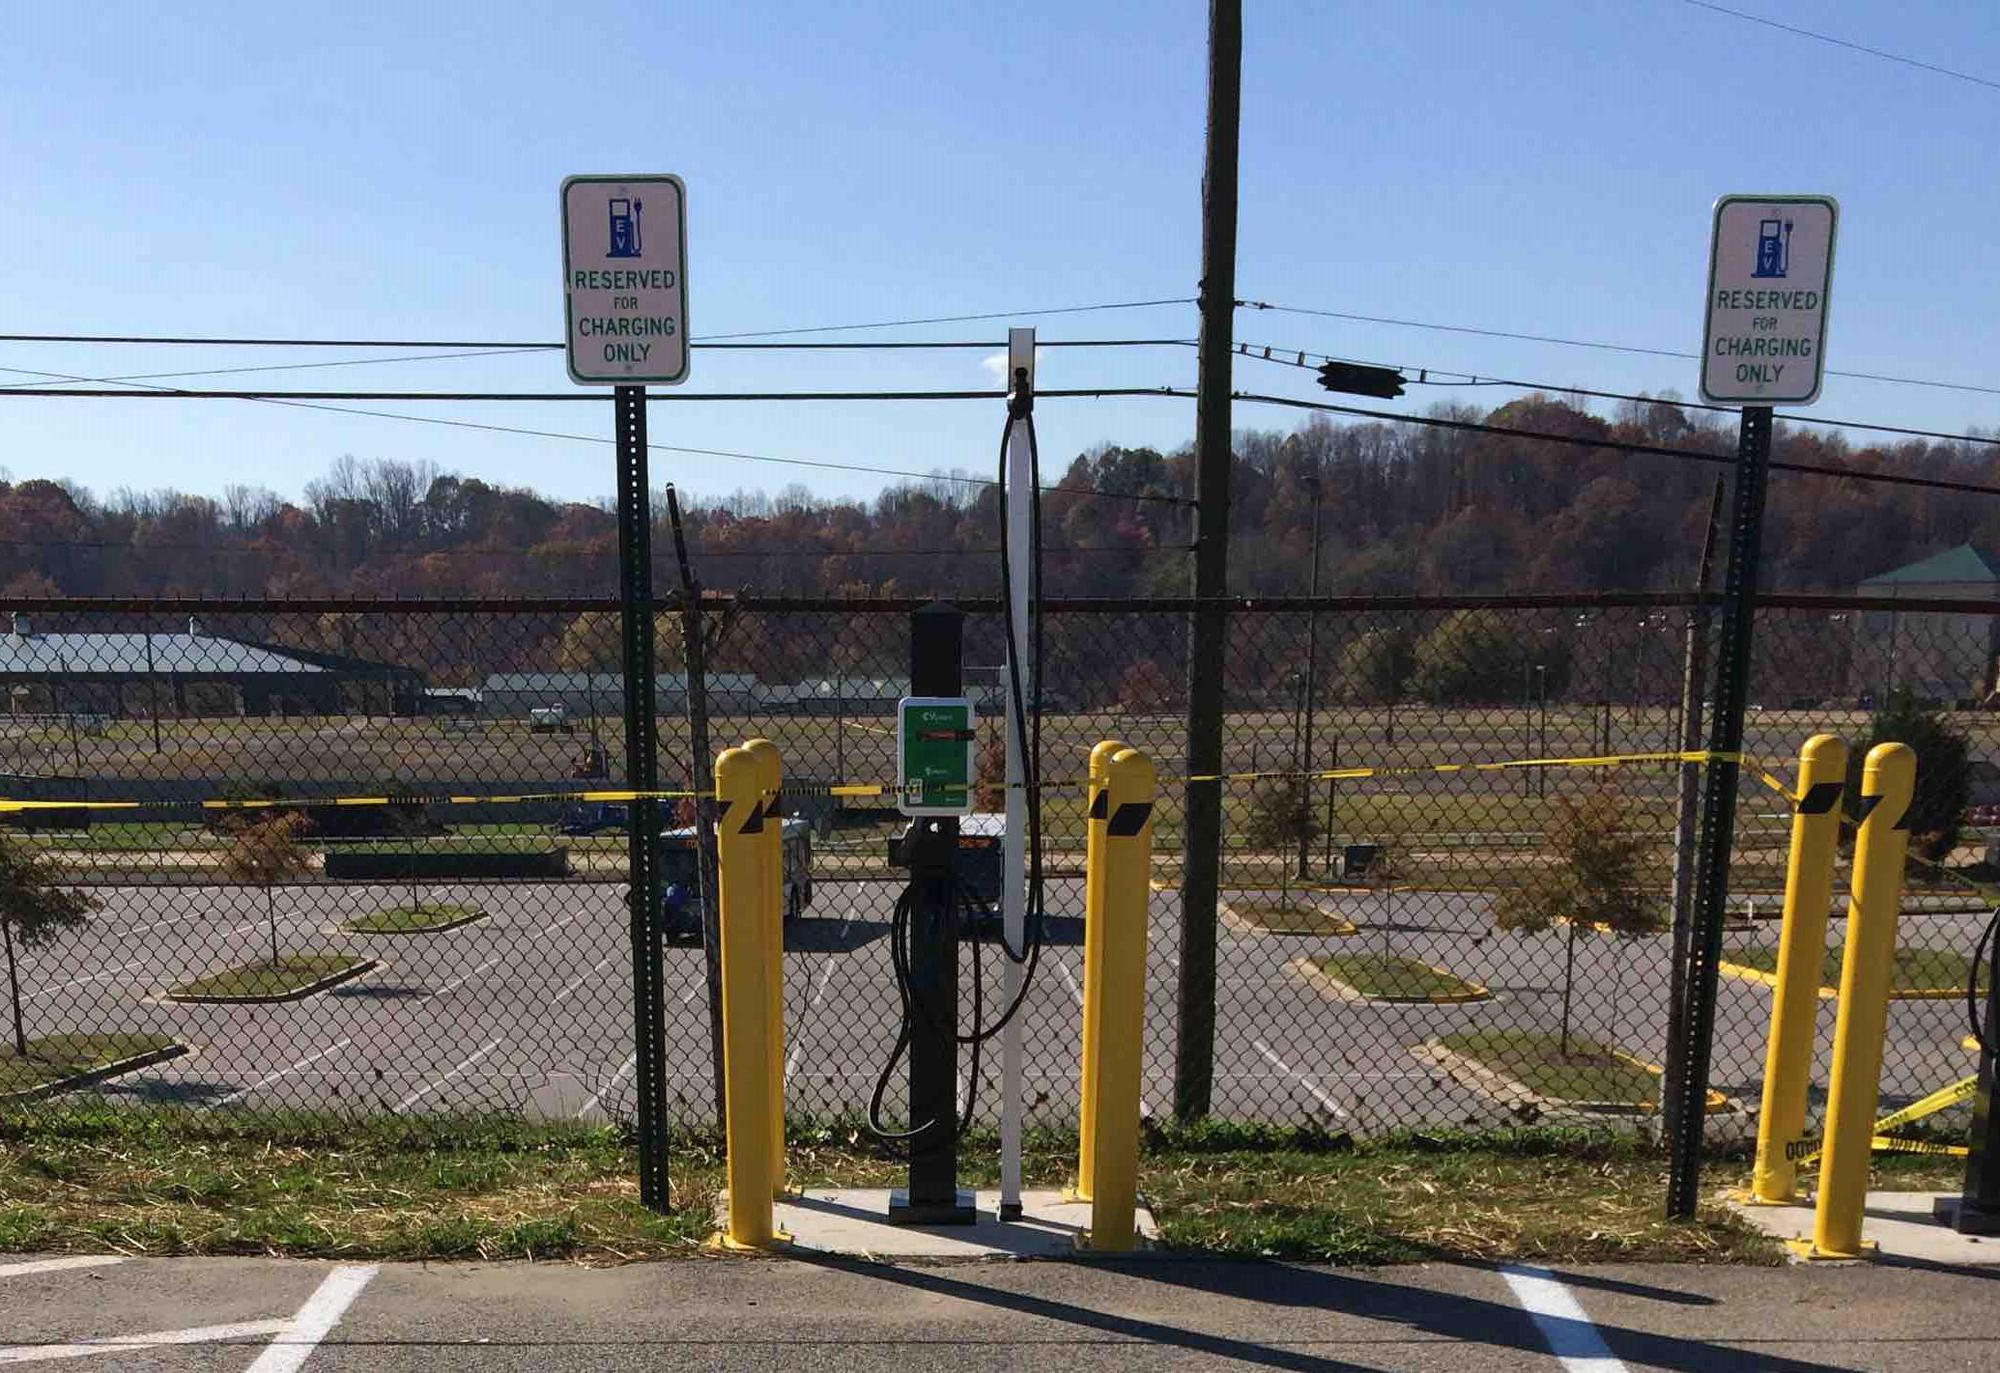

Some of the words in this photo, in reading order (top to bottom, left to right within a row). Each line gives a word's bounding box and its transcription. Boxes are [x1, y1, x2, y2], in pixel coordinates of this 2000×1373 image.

[575, 270, 675, 289] RESERVED
[614, 297, 638, 310] FOR
[1718, 290, 1818, 309] RESERVED
[579, 317, 675, 337] CHARGING
[1752, 317, 1778, 331] FOR
[604, 343, 651, 362] ONLY
[1715, 338, 1811, 357] CHARGING
[1736, 364, 1784, 383] ONLY
